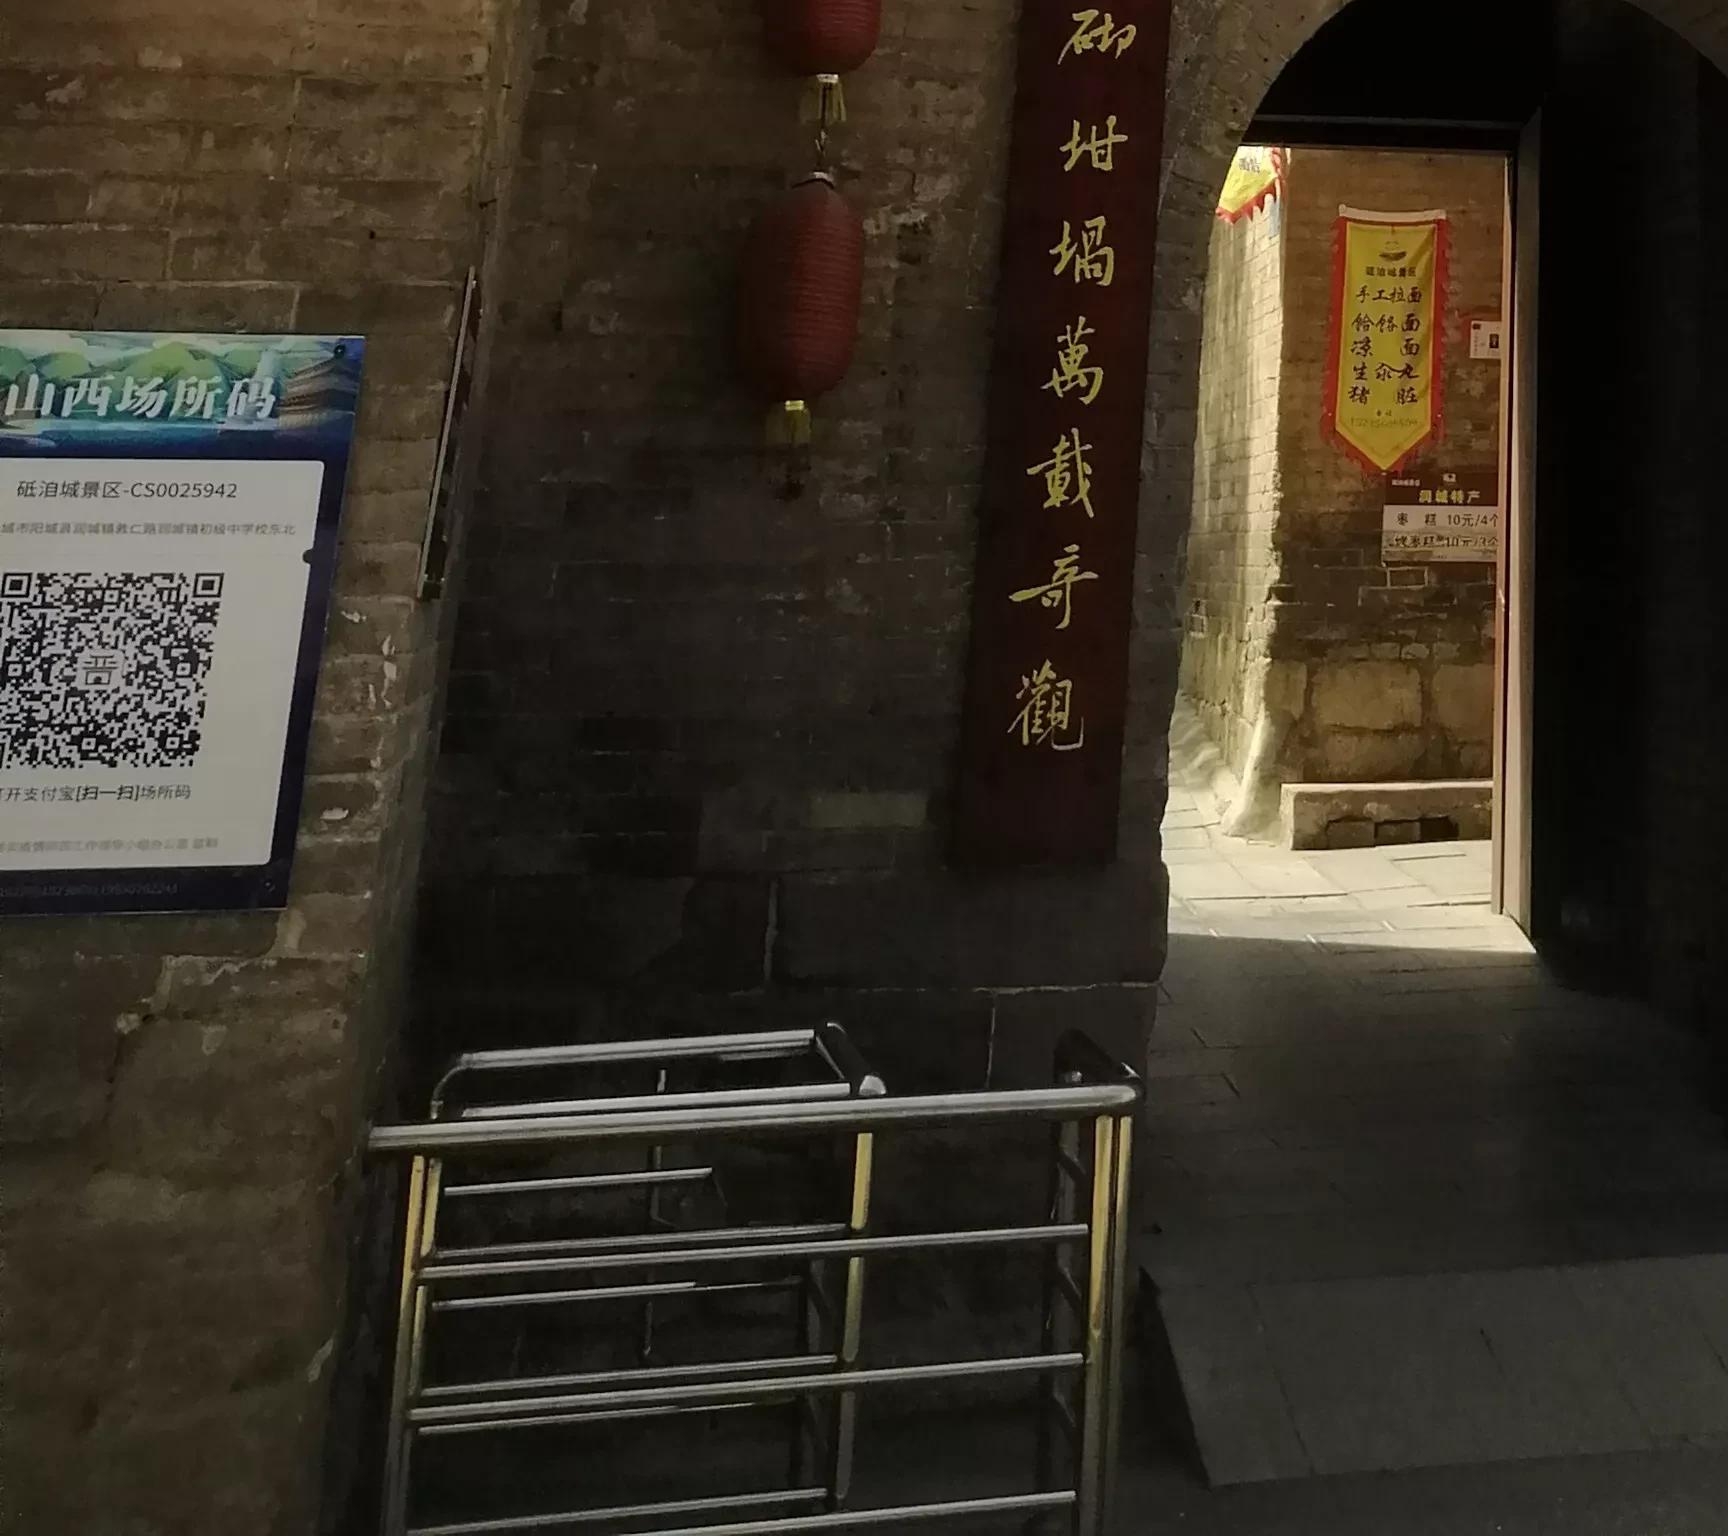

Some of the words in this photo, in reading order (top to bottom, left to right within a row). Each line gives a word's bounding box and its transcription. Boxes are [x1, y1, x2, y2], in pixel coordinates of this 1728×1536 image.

[1355, 284, 1423, 304] 手工拉面
[4, 373, 278, 419] 山西场所码
[16, 480, 238, 499] 砥洎城景区-CS0025942
